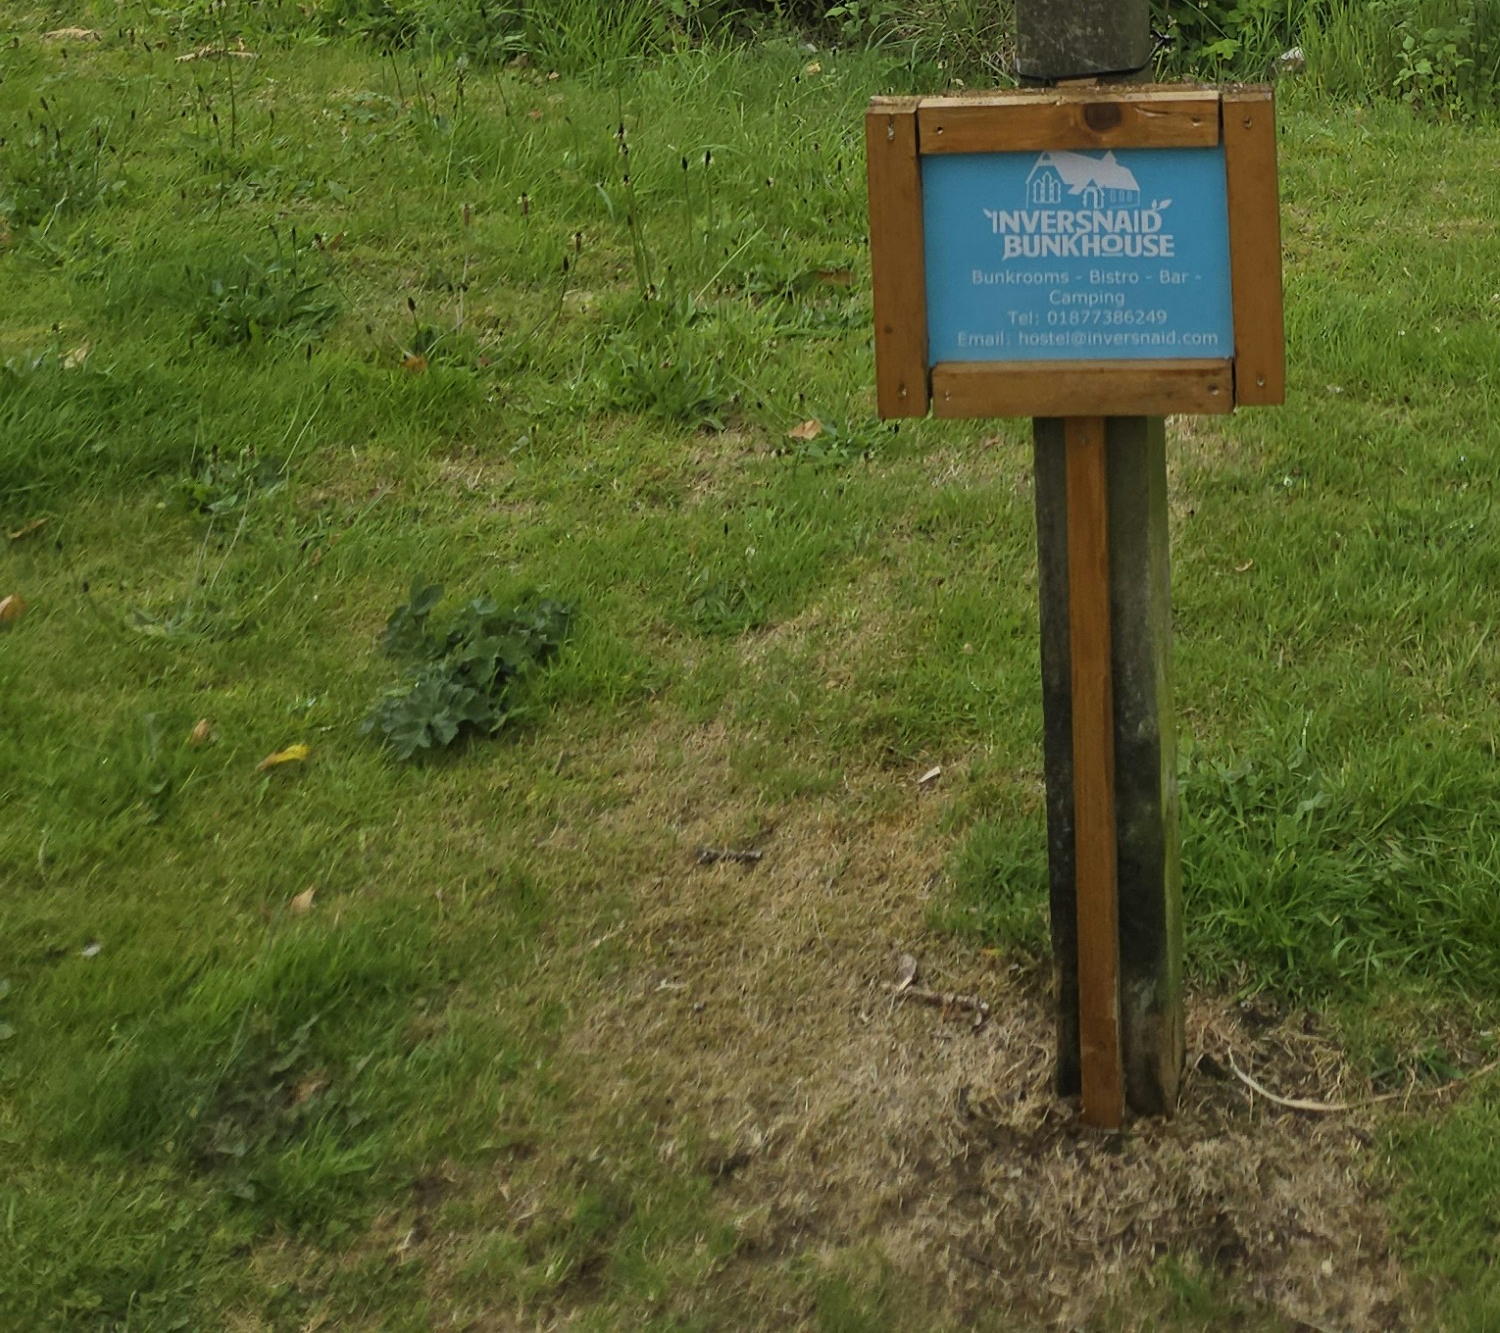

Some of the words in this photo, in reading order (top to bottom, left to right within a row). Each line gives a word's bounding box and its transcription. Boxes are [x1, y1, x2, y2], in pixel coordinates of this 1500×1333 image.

[987, 207, 1164, 234] INVERSNAID
[1002, 232, 1176, 261] BUNKHOUSE
[971, 269, 1069, 285] Bunkrooms
[1089, 269, 1139, 285] Bistro
[1159, 269, 1188, 285] Bar
[1049, 290, 1126, 307] Camping
[1008, 311, 1040, 325] Tel:
[1047, 309, 1168, 326] 01877386249
[1018, 330, 1219, 347] hostel@inversnaid.com
